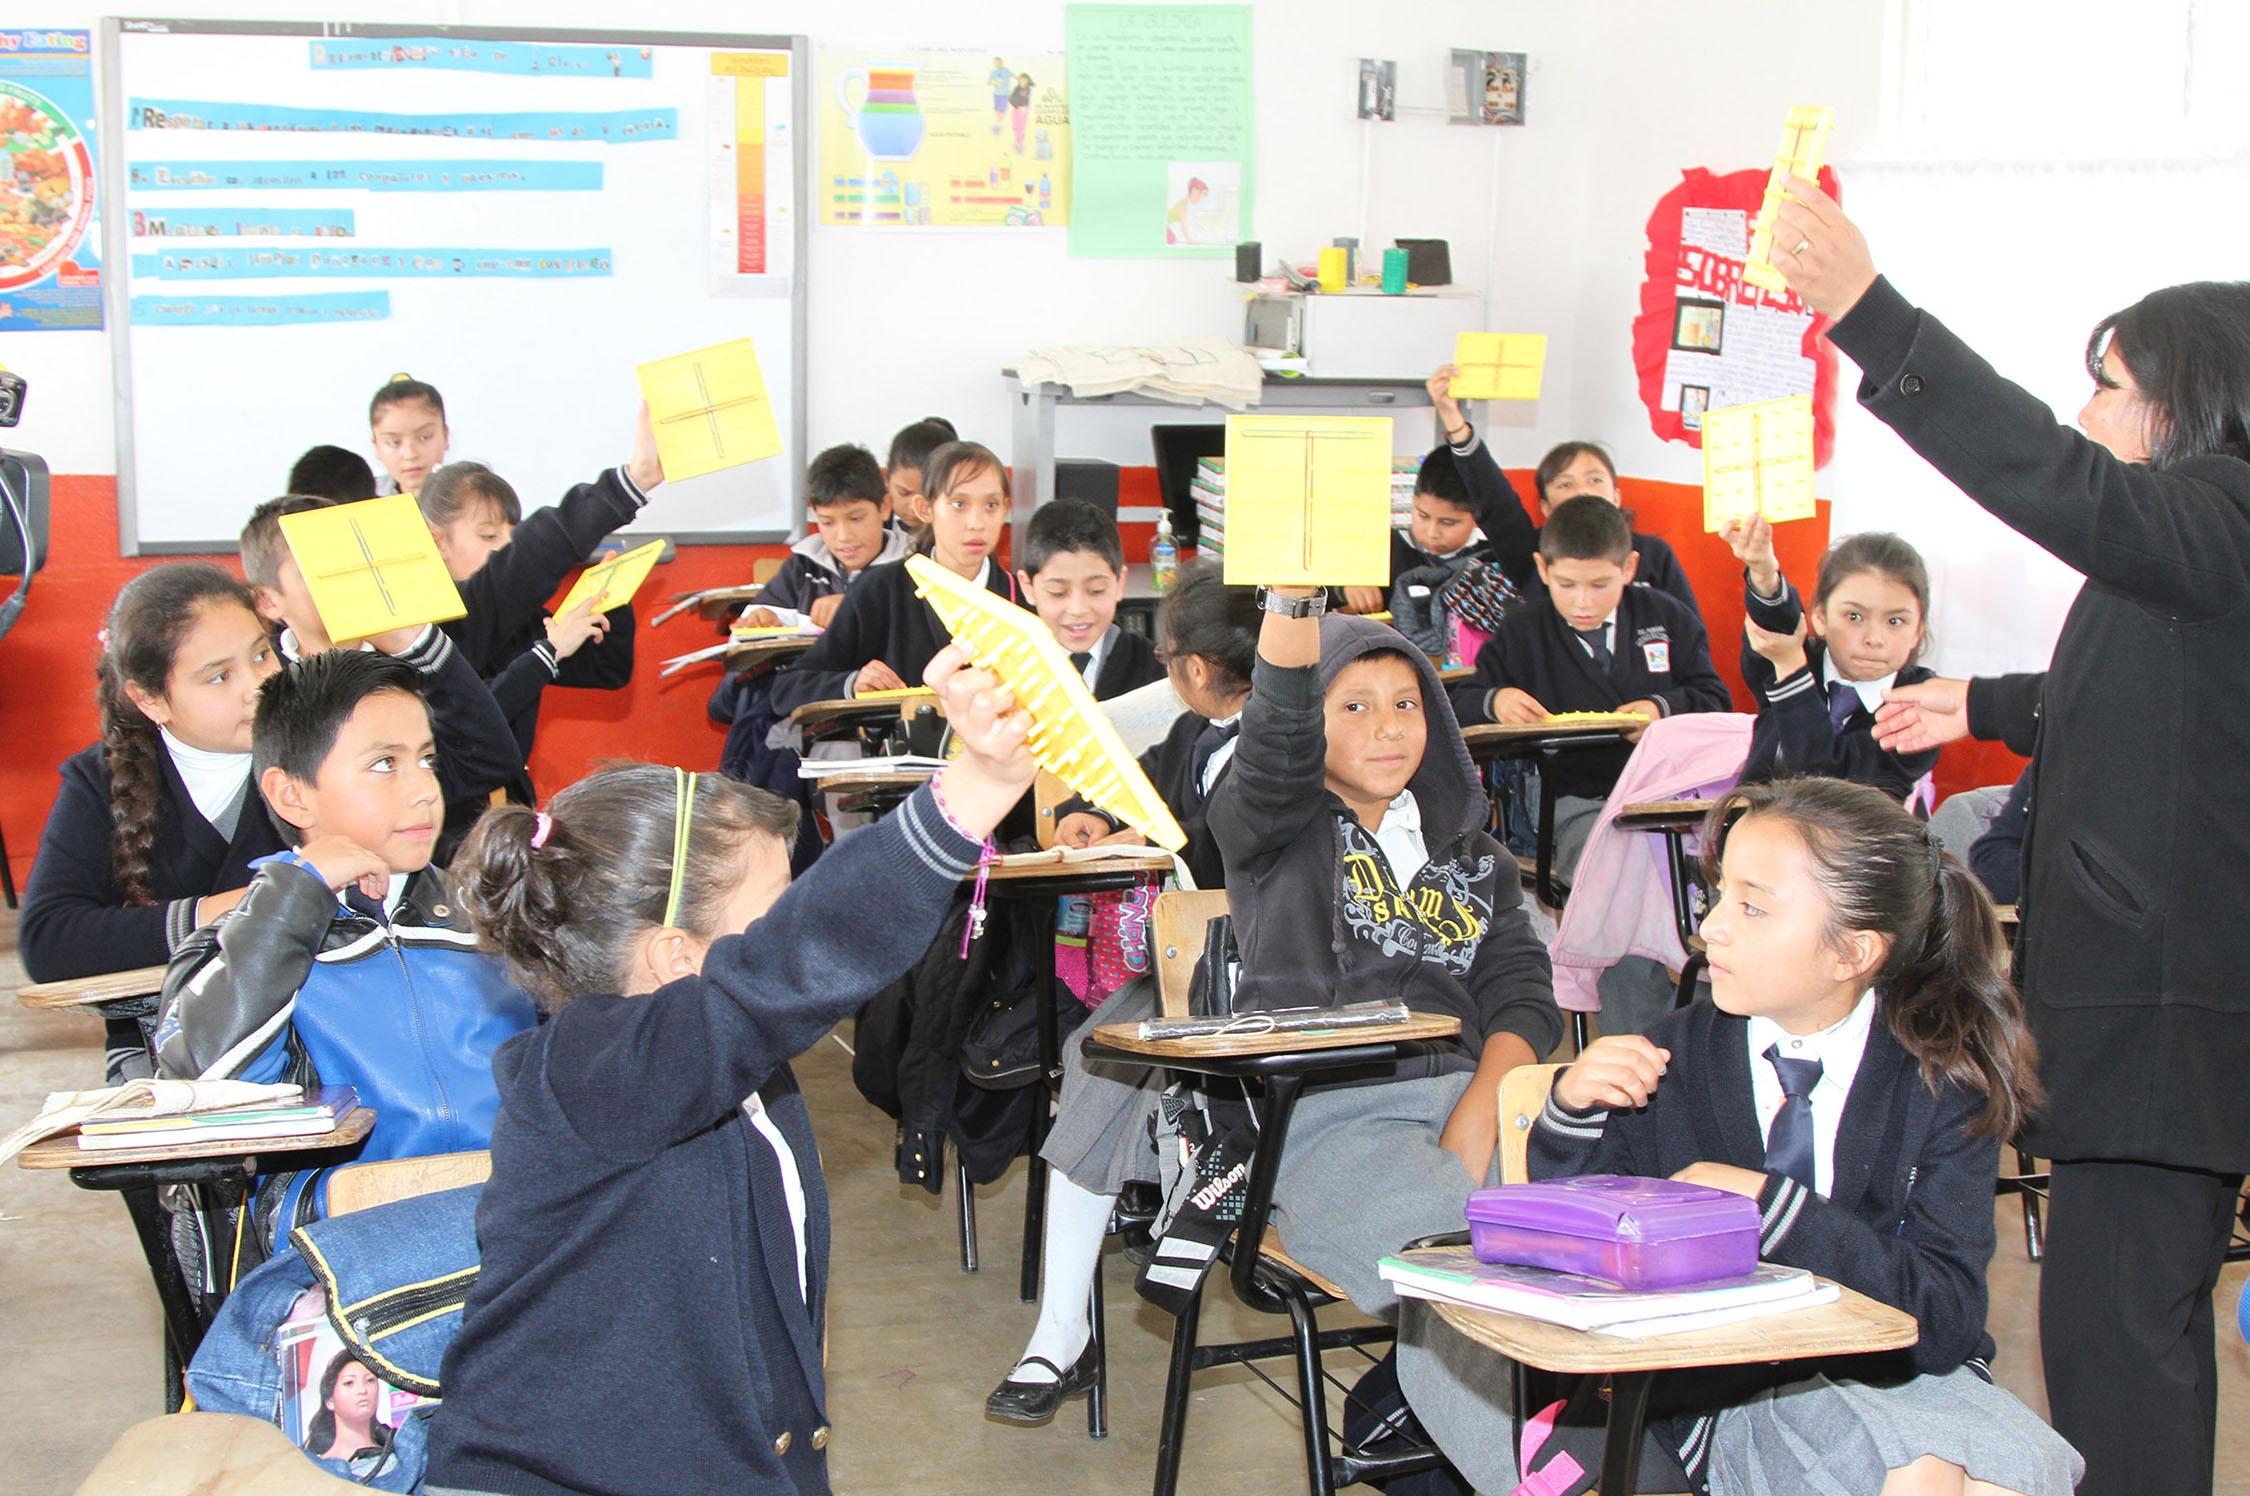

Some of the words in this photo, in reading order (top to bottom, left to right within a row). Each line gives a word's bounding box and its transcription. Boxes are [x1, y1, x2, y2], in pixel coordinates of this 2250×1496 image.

[23, 31, 87, 51] Eating
[1035, 114, 1070, 126] AGUA
[132, 210, 146, 237] 3
[1191, 1163, 1246, 1210] Wilson
